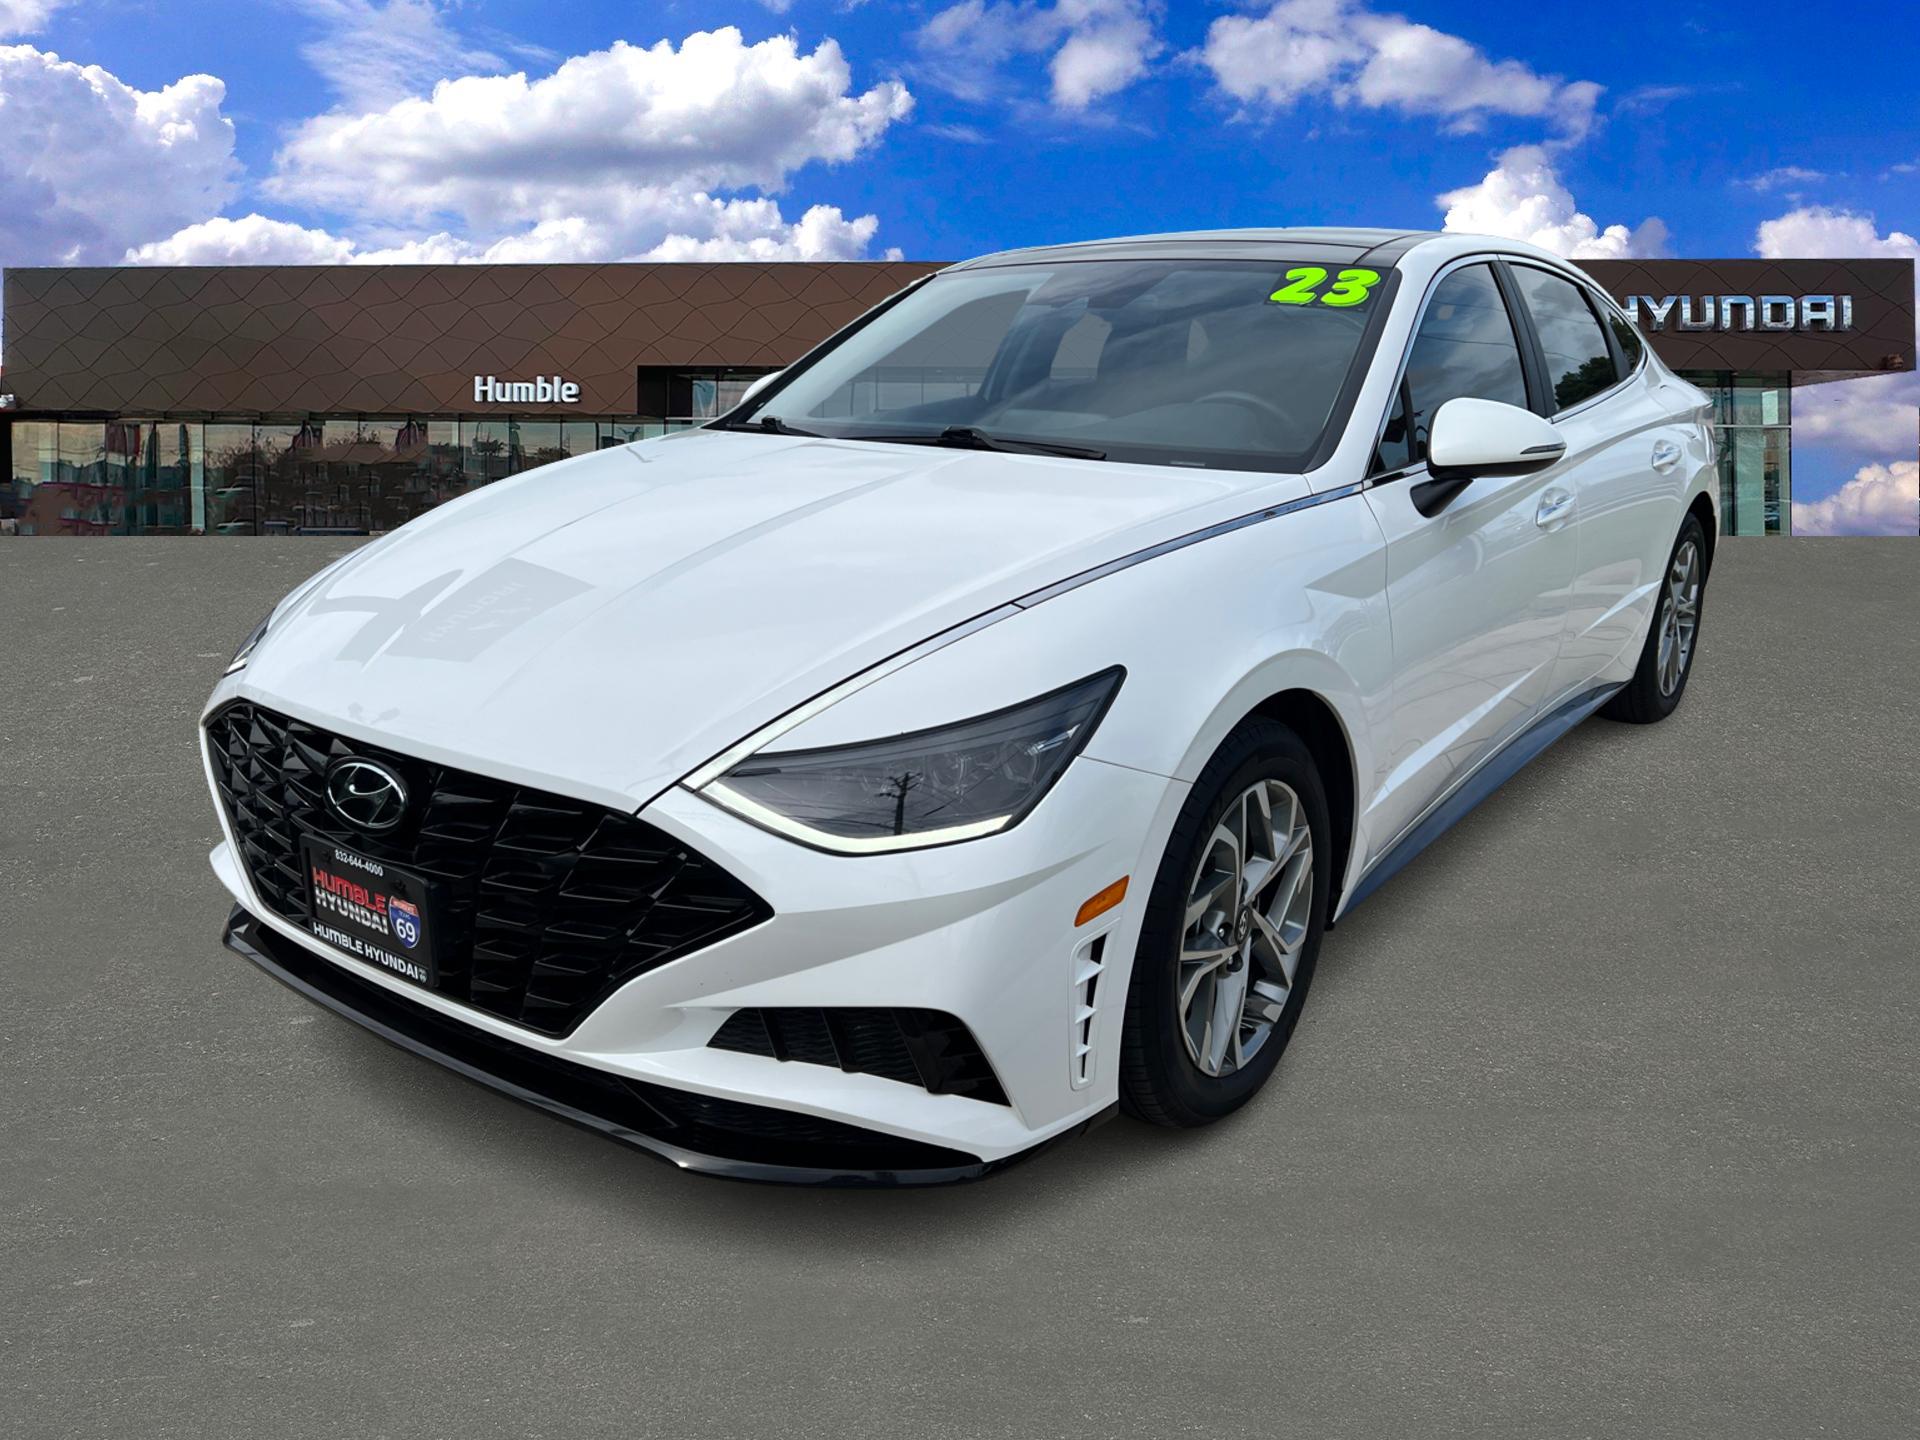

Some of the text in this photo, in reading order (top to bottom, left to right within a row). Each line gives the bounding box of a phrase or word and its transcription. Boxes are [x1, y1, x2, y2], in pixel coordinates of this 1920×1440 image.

[1269, 266, 1381, 307] 23
[474, 375, 580, 403] Humble
[312, 866, 387, 915] HUMBLE
[315, 886, 389, 935] HYUNDAI
[313, 922, 364, 955] HUMBLE
[364, 944, 418, 980] HYUNDAI
[396, 918, 416, 943] 69
